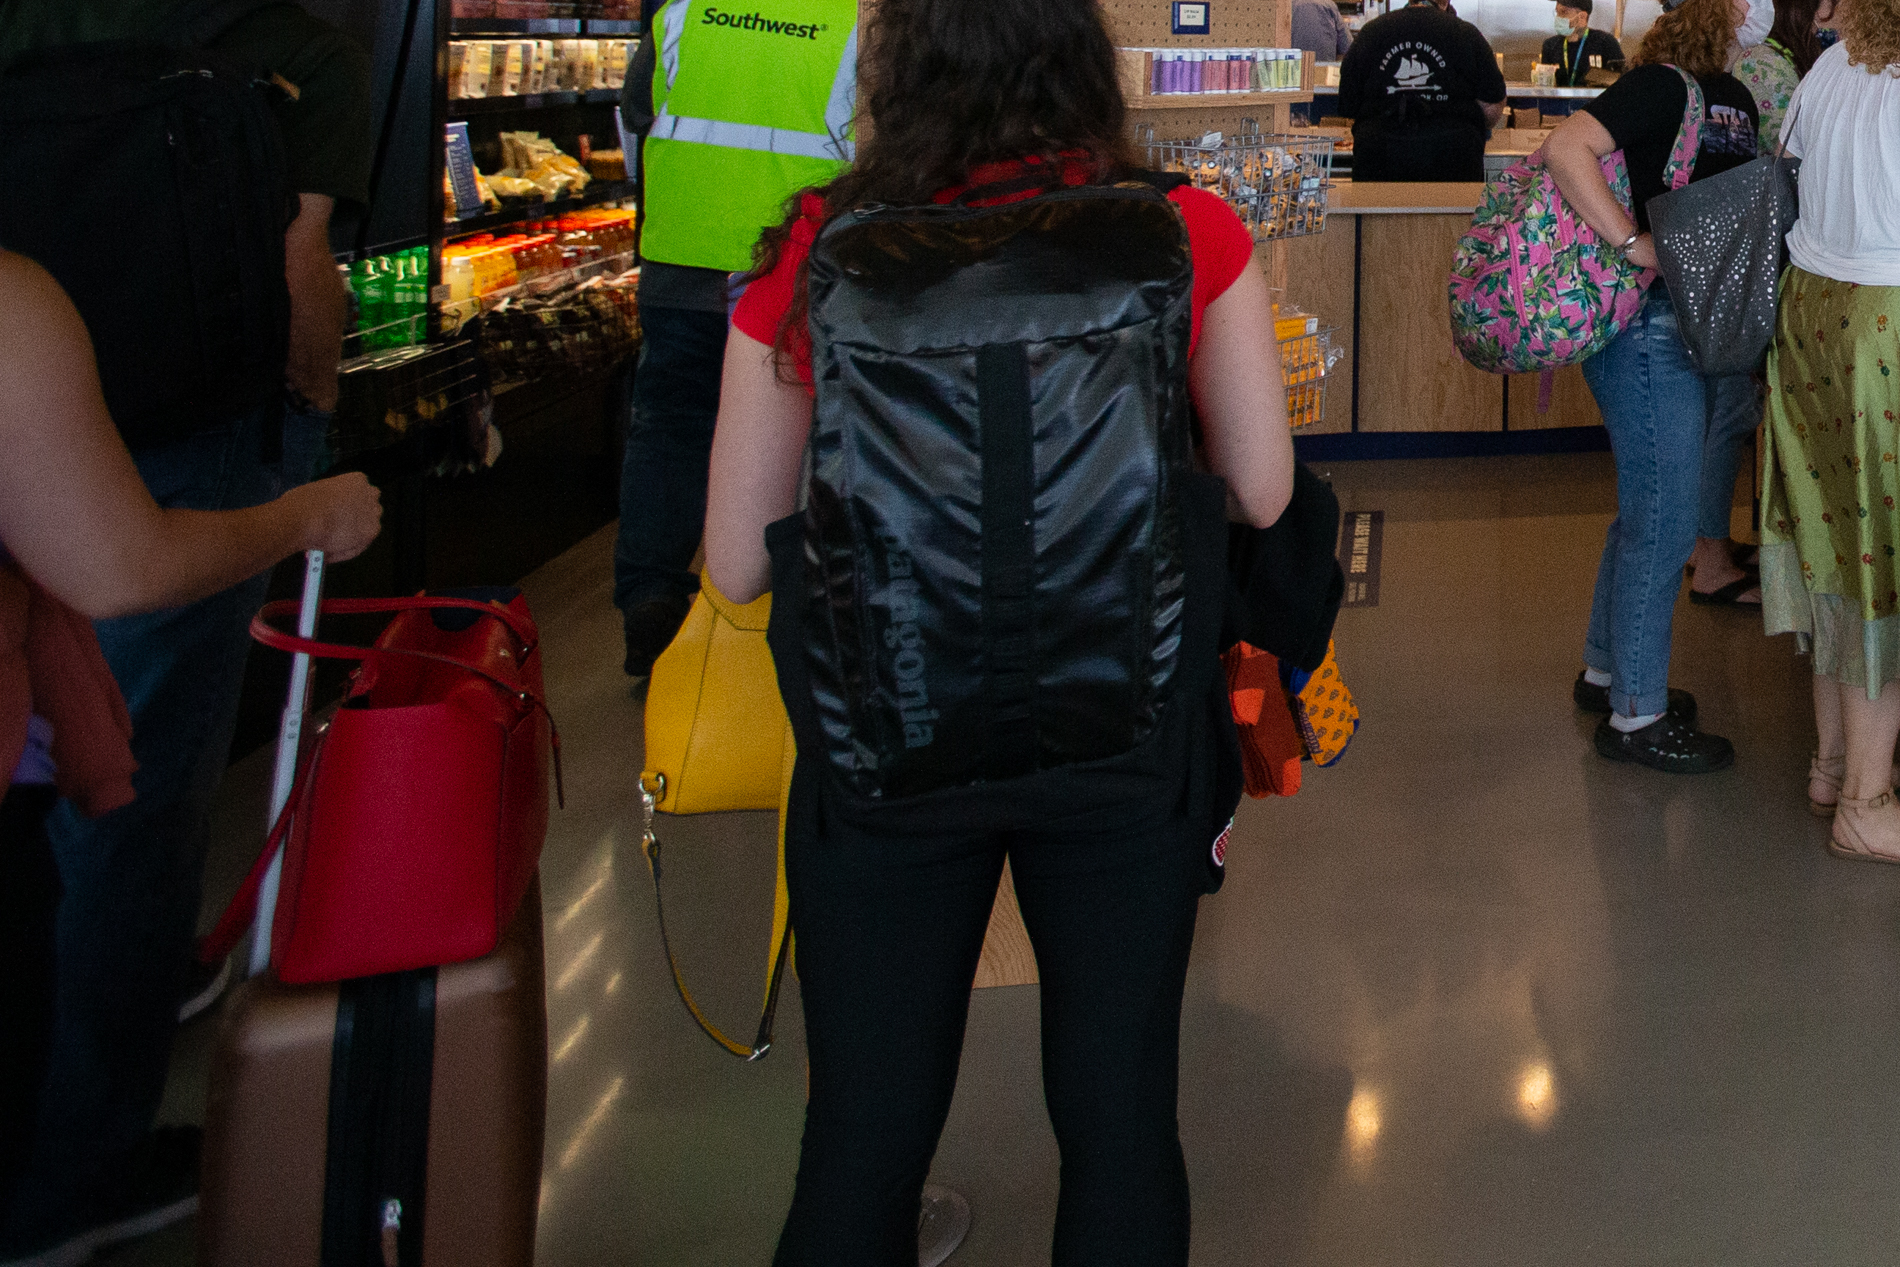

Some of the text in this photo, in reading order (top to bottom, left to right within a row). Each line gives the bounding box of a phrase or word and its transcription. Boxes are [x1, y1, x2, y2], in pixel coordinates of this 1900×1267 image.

[1380, 41, 1446, 71] FARMER OWNED
[1354, 514, 1371, 535] PLEASE
[1352, 536, 1370, 554] WAIT
[1350, 554, 1368, 573] HERE
